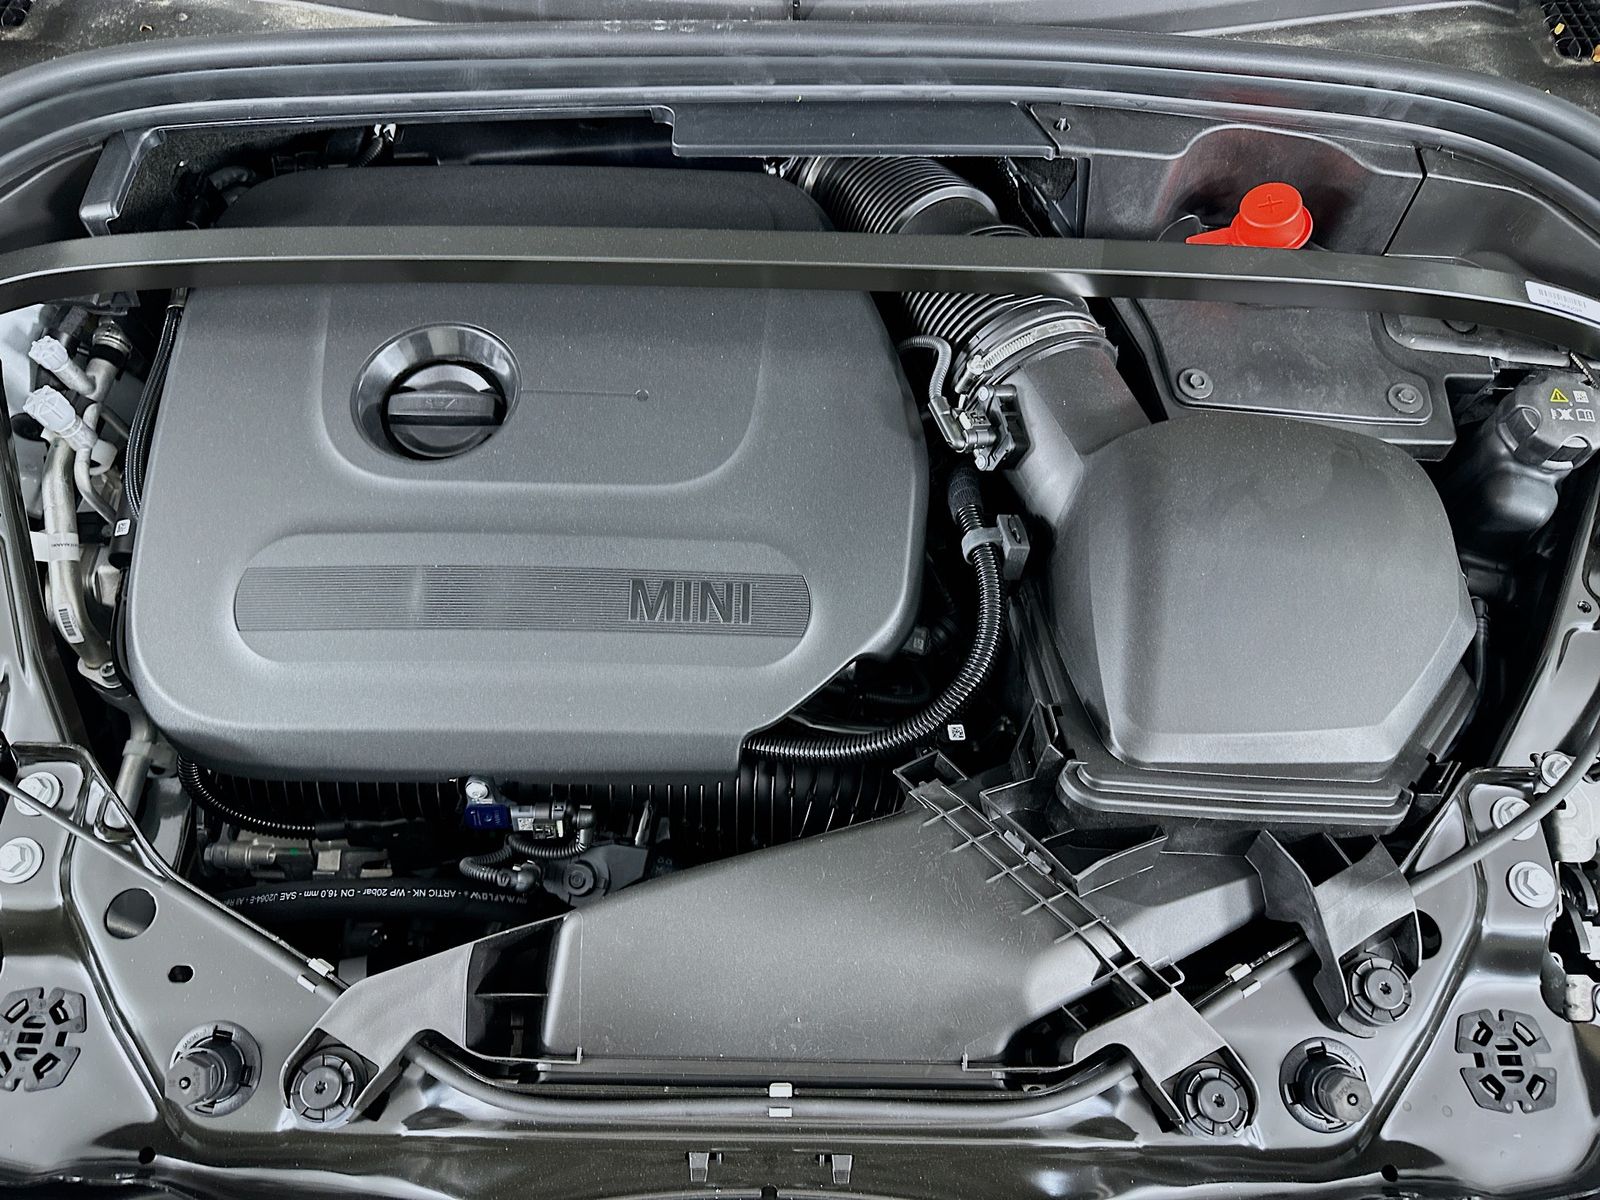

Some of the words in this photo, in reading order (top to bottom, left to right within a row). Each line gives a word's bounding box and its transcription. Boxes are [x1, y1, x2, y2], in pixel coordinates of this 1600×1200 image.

[628, 579, 752, 625] MINI
[280, 891, 297, 901] SAE
[321, 889, 338, 898] 16.0
[341, 888, 355, 897] DN
[363, 888, 388, 897] 20bar
[390, 889, 405, 897] WP
[412, 888, 426, 897] NK
[428, 889, 456, 898] ARTIC
[471, 891, 514, 903] MAFLOW
